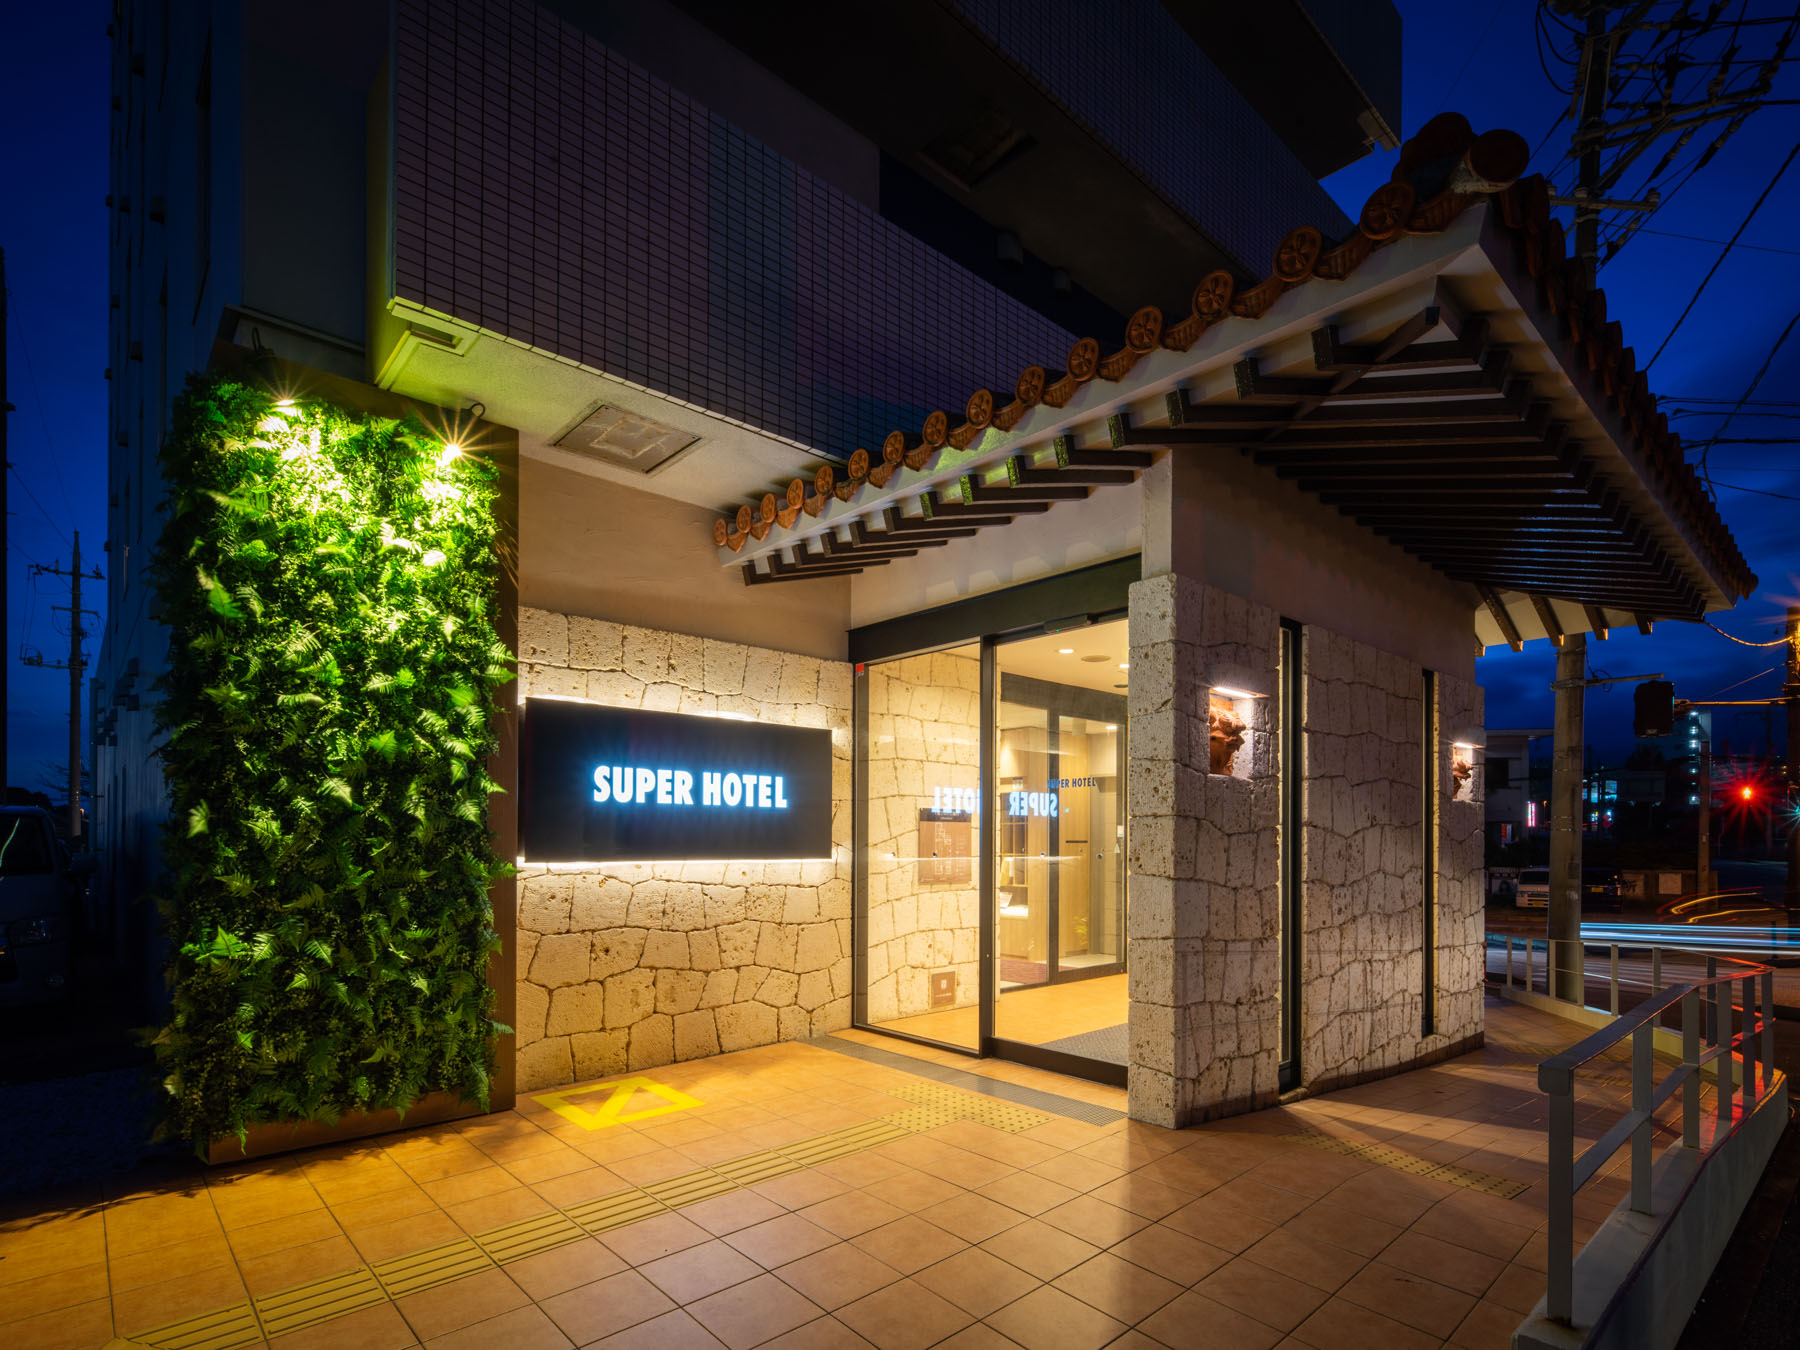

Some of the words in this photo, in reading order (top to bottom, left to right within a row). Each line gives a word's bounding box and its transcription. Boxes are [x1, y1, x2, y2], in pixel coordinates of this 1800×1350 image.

[593, 765, 694, 805] SUPER
[702, 771, 788, 808] HOTEL
[1072, 776, 1096, 788] HOTEL
